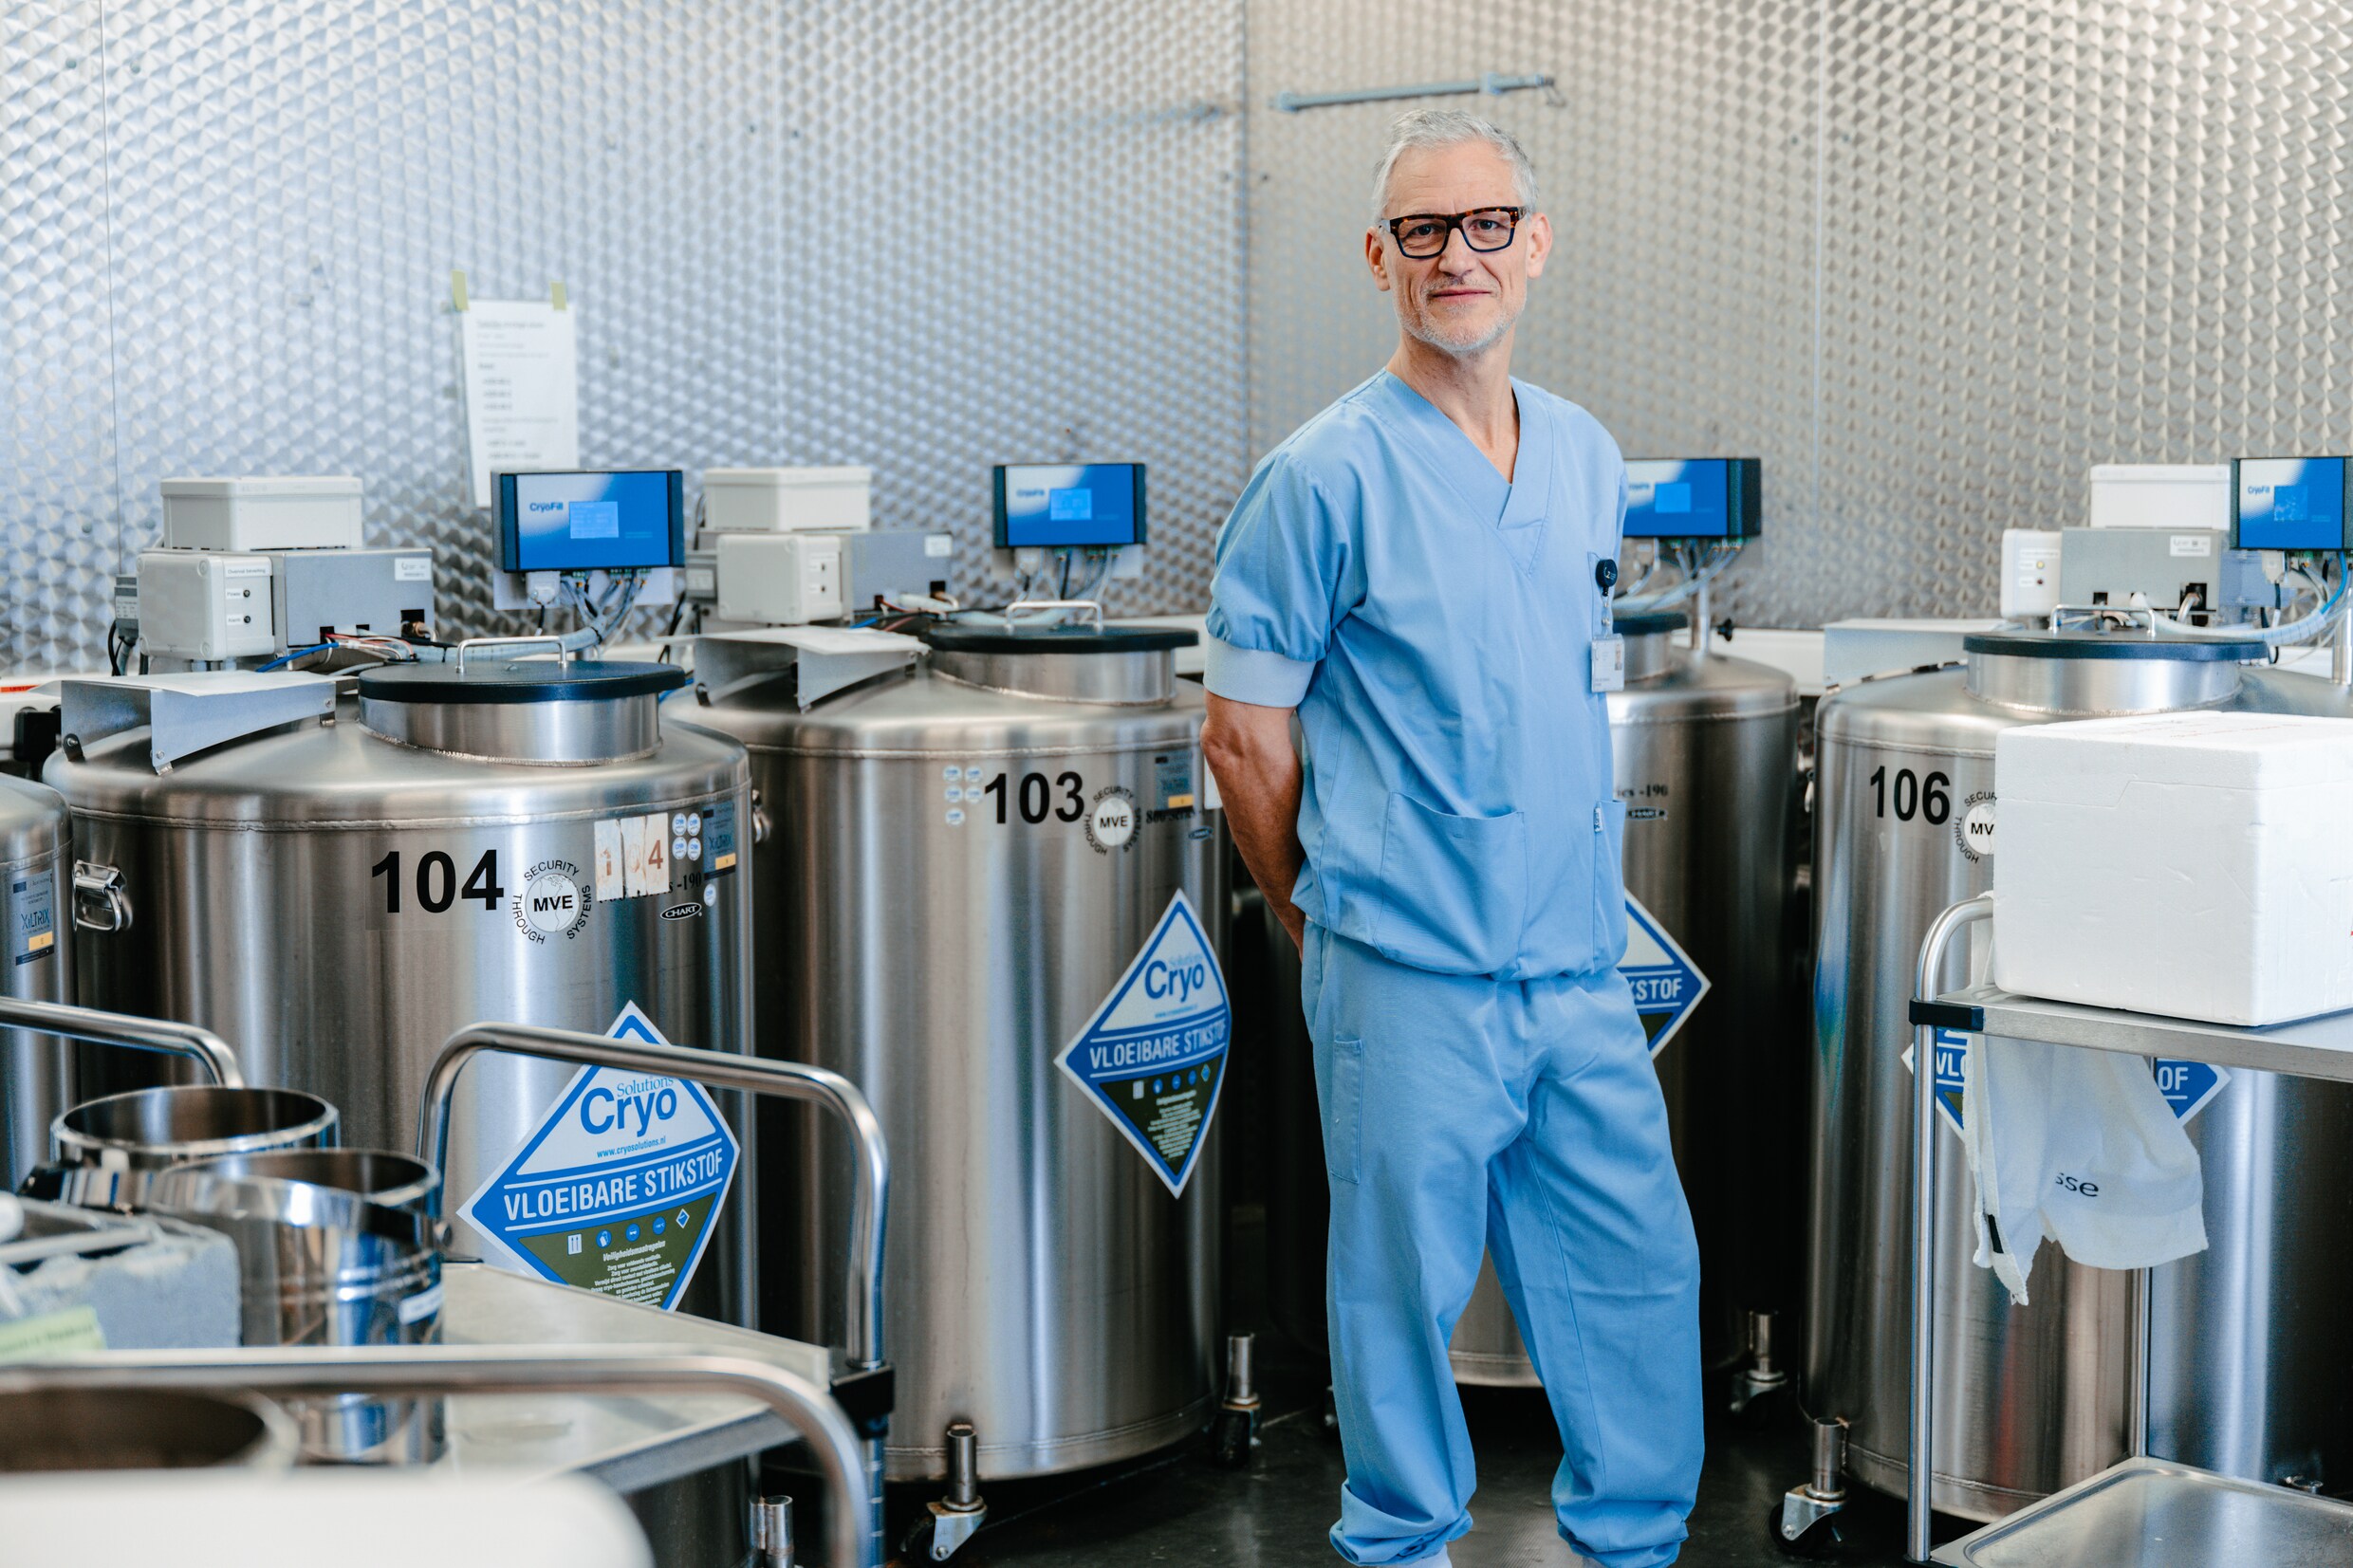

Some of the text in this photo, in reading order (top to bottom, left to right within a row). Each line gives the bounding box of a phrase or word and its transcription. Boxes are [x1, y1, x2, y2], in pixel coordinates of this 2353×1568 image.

[529, 502, 564, 513] CryoFill
[985, 771, 1084, 824] 103
[1093, 785, 1134, 803] SECURITY
[1870, 766, 1951, 825] 106
[1084, 812, 1108, 856] THROUGH
[1100, 816, 1129, 829] MVE
[1971, 822, 1994, 835] MV
[1954, 817, 1979, 864] THROUGH
[371, 849, 505, 913] 104
[524, 859, 581, 882] SECURITY
[533, 895, 574, 913] MVE
[566, 884, 592, 940] SYSTEMS
[664, 904, 698, 918] CHART
[512, 894, 547, 945] THROUGH
[1144, 960, 1205, 1004] Cryo
[1630, 978, 1682, 1002] STOF
[1089, 1034, 1181, 1070] VLOEIBARE
[617, 1076, 675, 1098] Solutions
[2158, 1066, 2189, 1091] OF
[580, 1087, 677, 1138] Cryo
[597, 1135, 667, 1159] www.cryosolutions.nl
[504, 1148, 722, 1221] VLOEIBARE STIKSTOF
